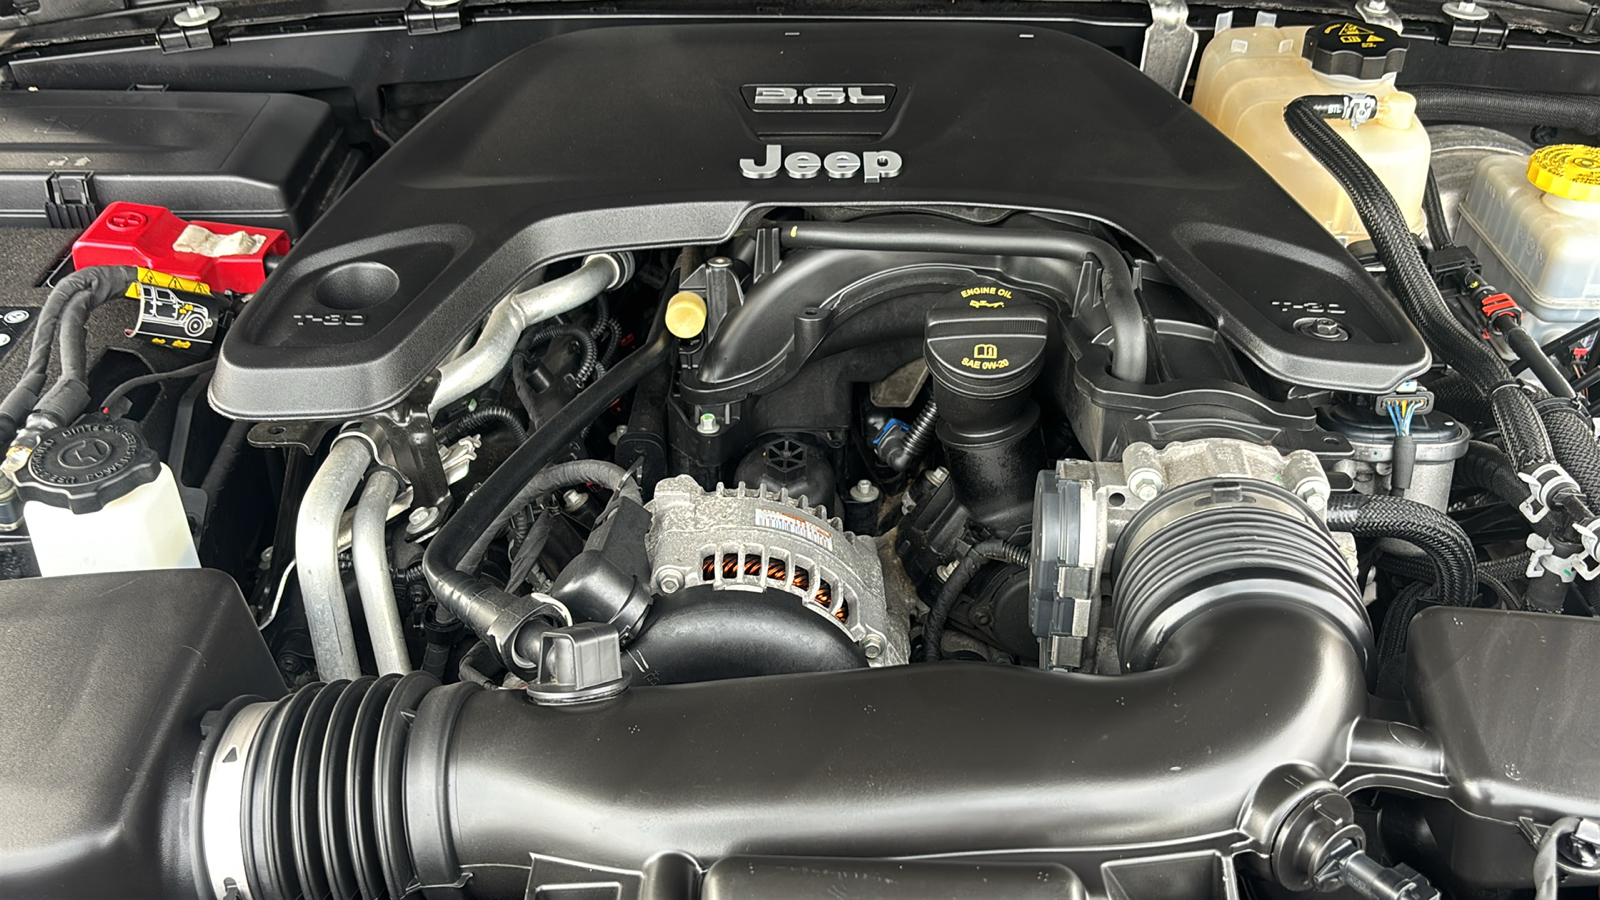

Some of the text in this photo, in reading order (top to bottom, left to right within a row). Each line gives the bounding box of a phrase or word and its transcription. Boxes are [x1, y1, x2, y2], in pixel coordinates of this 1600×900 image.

[754, 87, 886, 104] 3.6L
[739, 144, 903, 183] Jeep
[960, 286, 1012, 299] ENGINE OIL
[961, 357, 1010, 370] SAE 0W-20
[62, 423, 138, 481] POWER STEERING FLUID
[49, 473, 76, 484] USE
